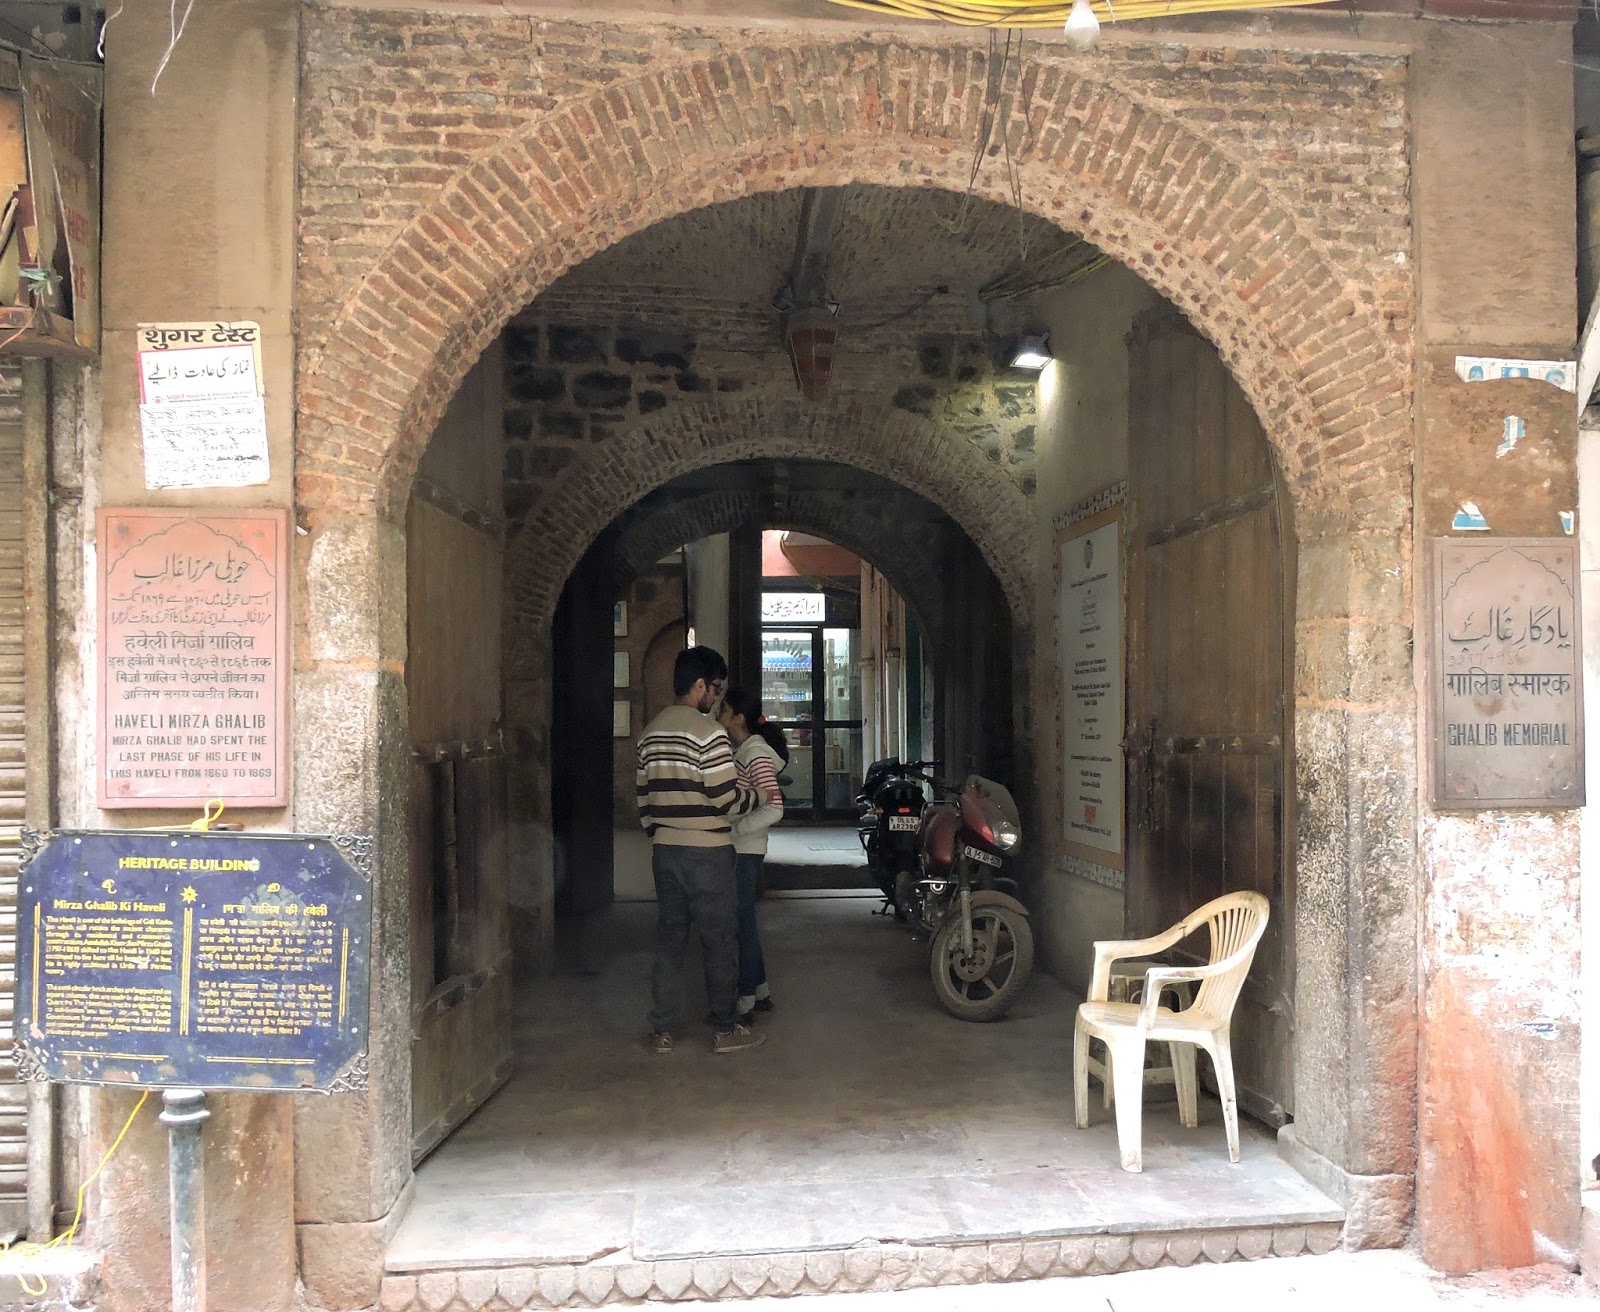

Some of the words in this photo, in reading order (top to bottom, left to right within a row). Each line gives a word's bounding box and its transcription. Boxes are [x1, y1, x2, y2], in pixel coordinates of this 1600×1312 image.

[211, 323, 257, 343] टेस्ट
[134, 552, 185, 585] غالب
[187, 555, 215, 583] مرزا
[215, 549, 250, 583] حویلی
[123, 630, 168, 653] हवेली
[127, 653, 155, 669] हवेली
[250, 657, 272, 667] तक
[1507, 673, 1571, 697] स्मारक
[114, 714, 164, 729] HAVELI
[168, 714, 210, 729] MIRZA
[215, 714, 266, 729] GHALIB
[112, 735, 142, 746] MIRZA
[146, 735, 182, 746] GHALIB
[186, 735, 206, 746] HAD
[210, 735, 243, 746] SPENT
[248, 735, 267, 746] THE
[1448, 723, 1498, 746] GHALIB
[1503, 723, 1570, 747] MEMORIAL
[119, 752, 146, 762] LAST
[150, 752, 184, 762] PHASE
[188, 752, 200, 762] OF
[205, 752, 221, 762] HIS
[225, 752, 248, 762] LIFE
[251, 752, 261, 762] IN
[109, 768, 131, 779] THIS
[135, 768, 170, 779] HAVELI
[175, 768, 201, 779] FROM
[204, 768, 228, 779] 1860
[233, 768, 246, 779] TO
[249, 768, 272, 779] 1869
[118, 857, 187, 870] HERITAGE
[190, 858, 260, 872] BUILDING
[53, 899, 82, 910] Mirza
[84, 900, 118, 911] Ghalib
[120, 901, 131, 911] Ki
[133, 902, 166, 912] Haveli
